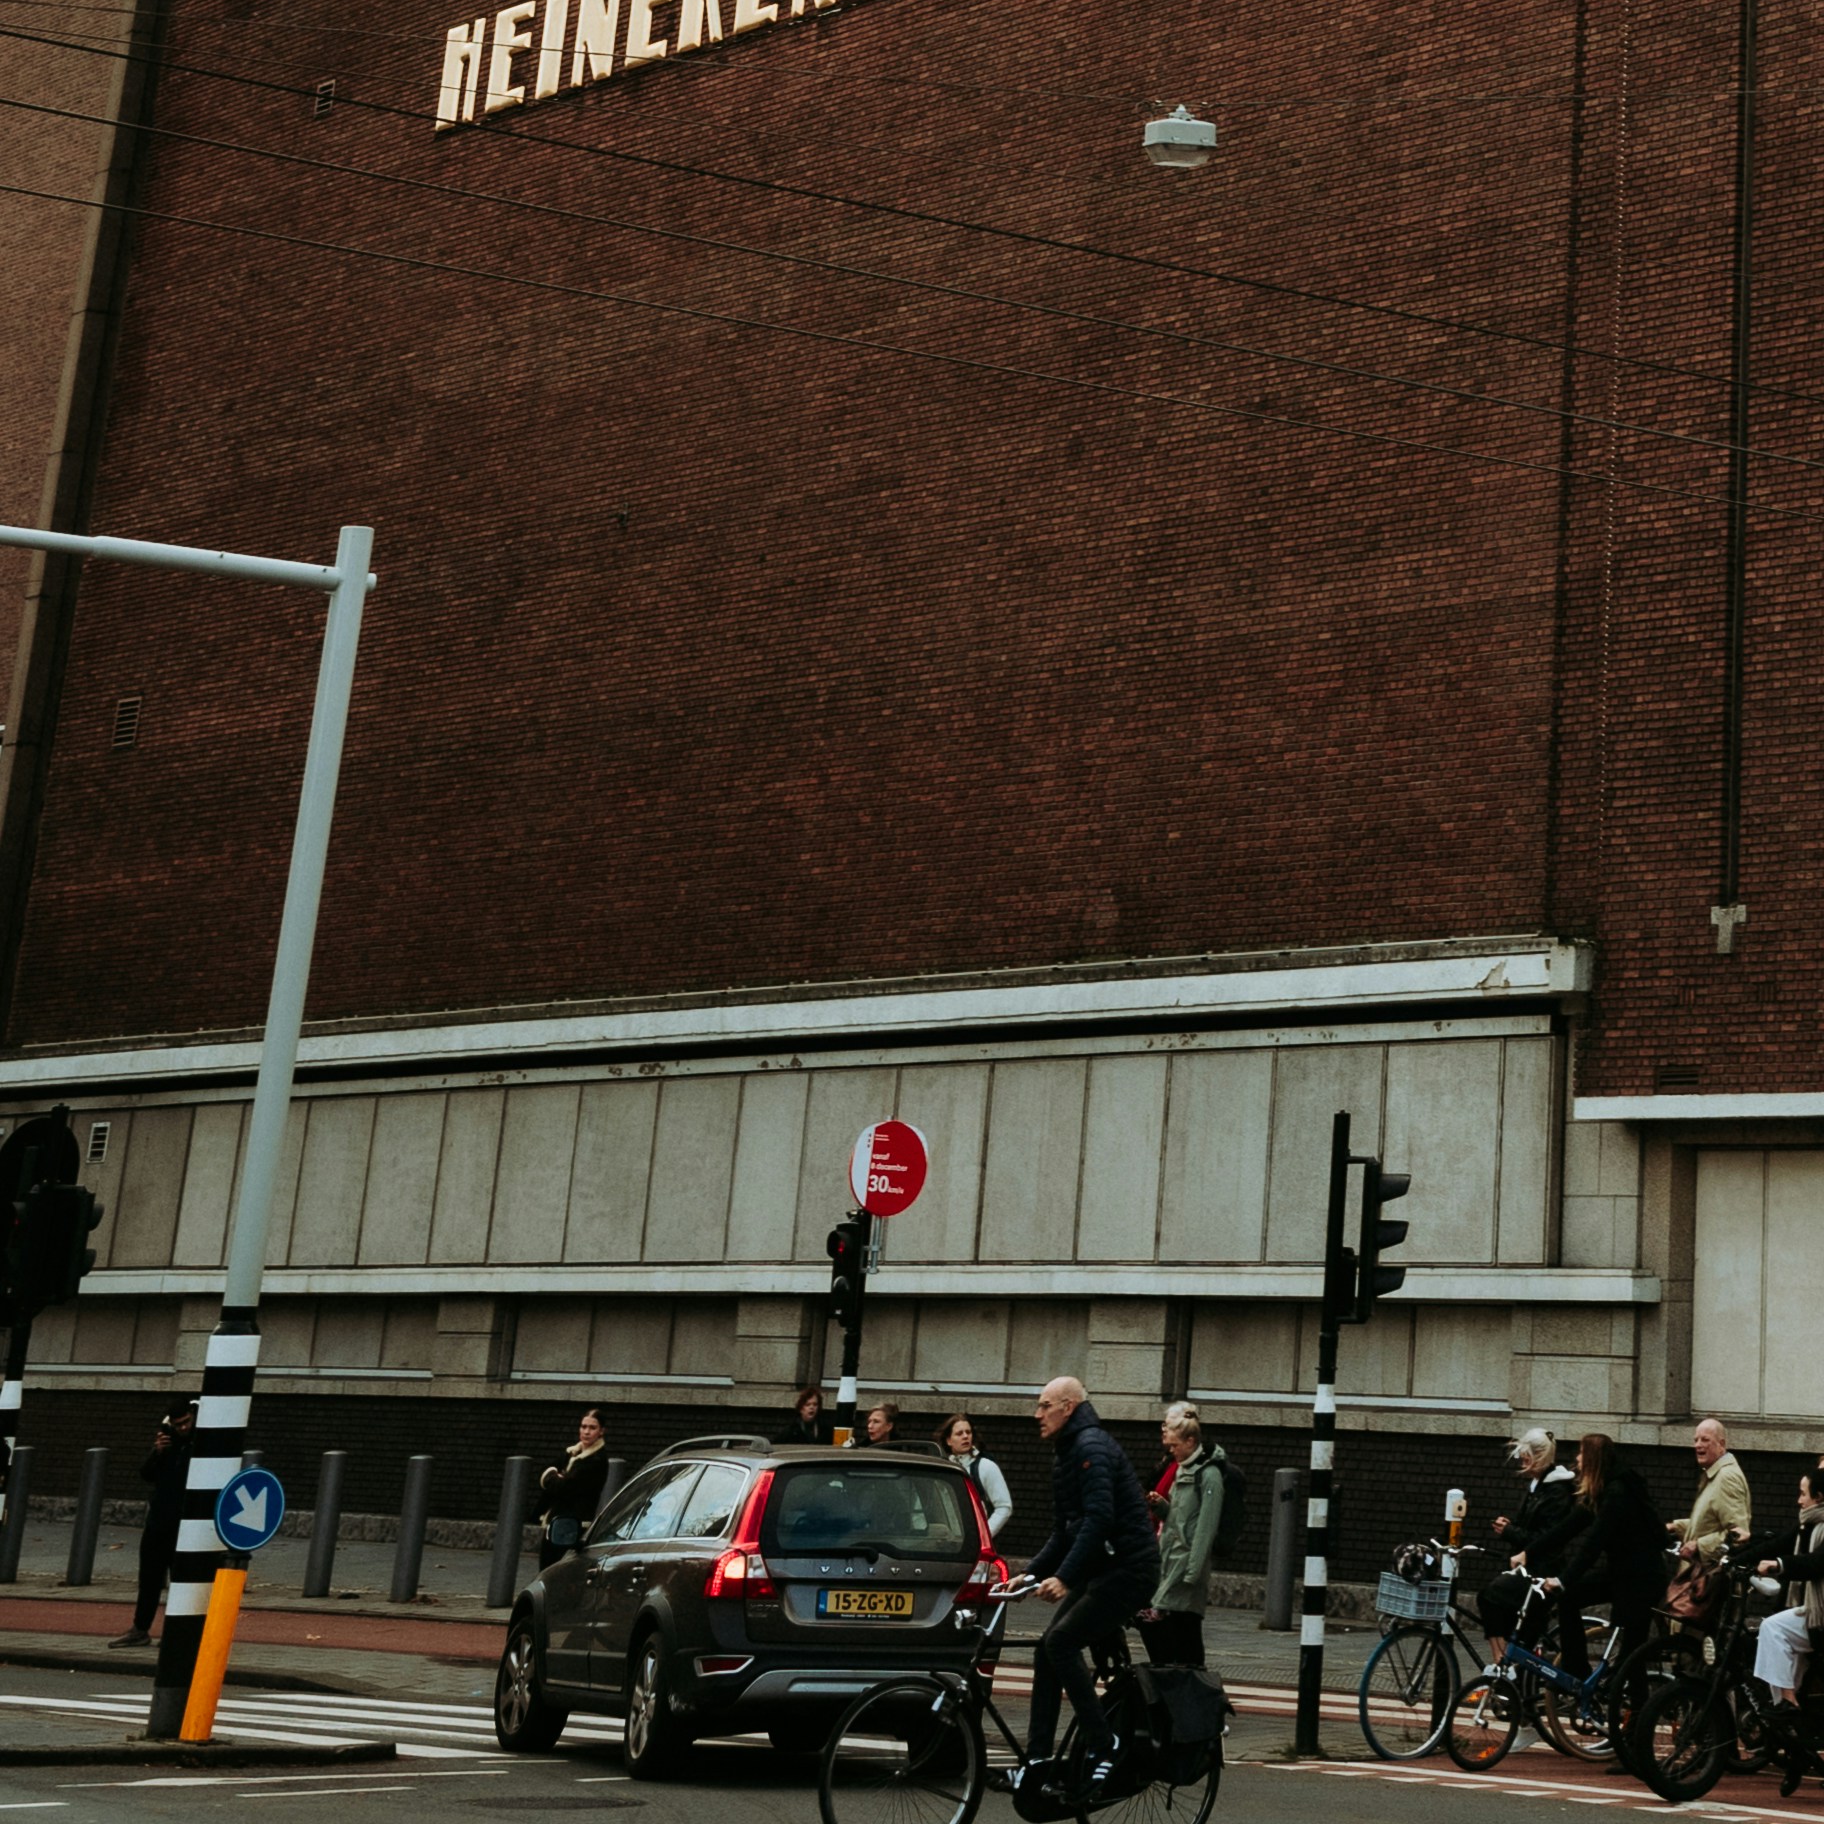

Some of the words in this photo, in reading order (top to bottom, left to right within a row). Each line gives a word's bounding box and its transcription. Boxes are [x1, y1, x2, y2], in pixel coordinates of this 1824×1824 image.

[868, 1174, 890, 1193] 30
[821, 1565, 922, 1575] VOLVO
[835, 1593, 905, 1611] 15-ZG-XD
